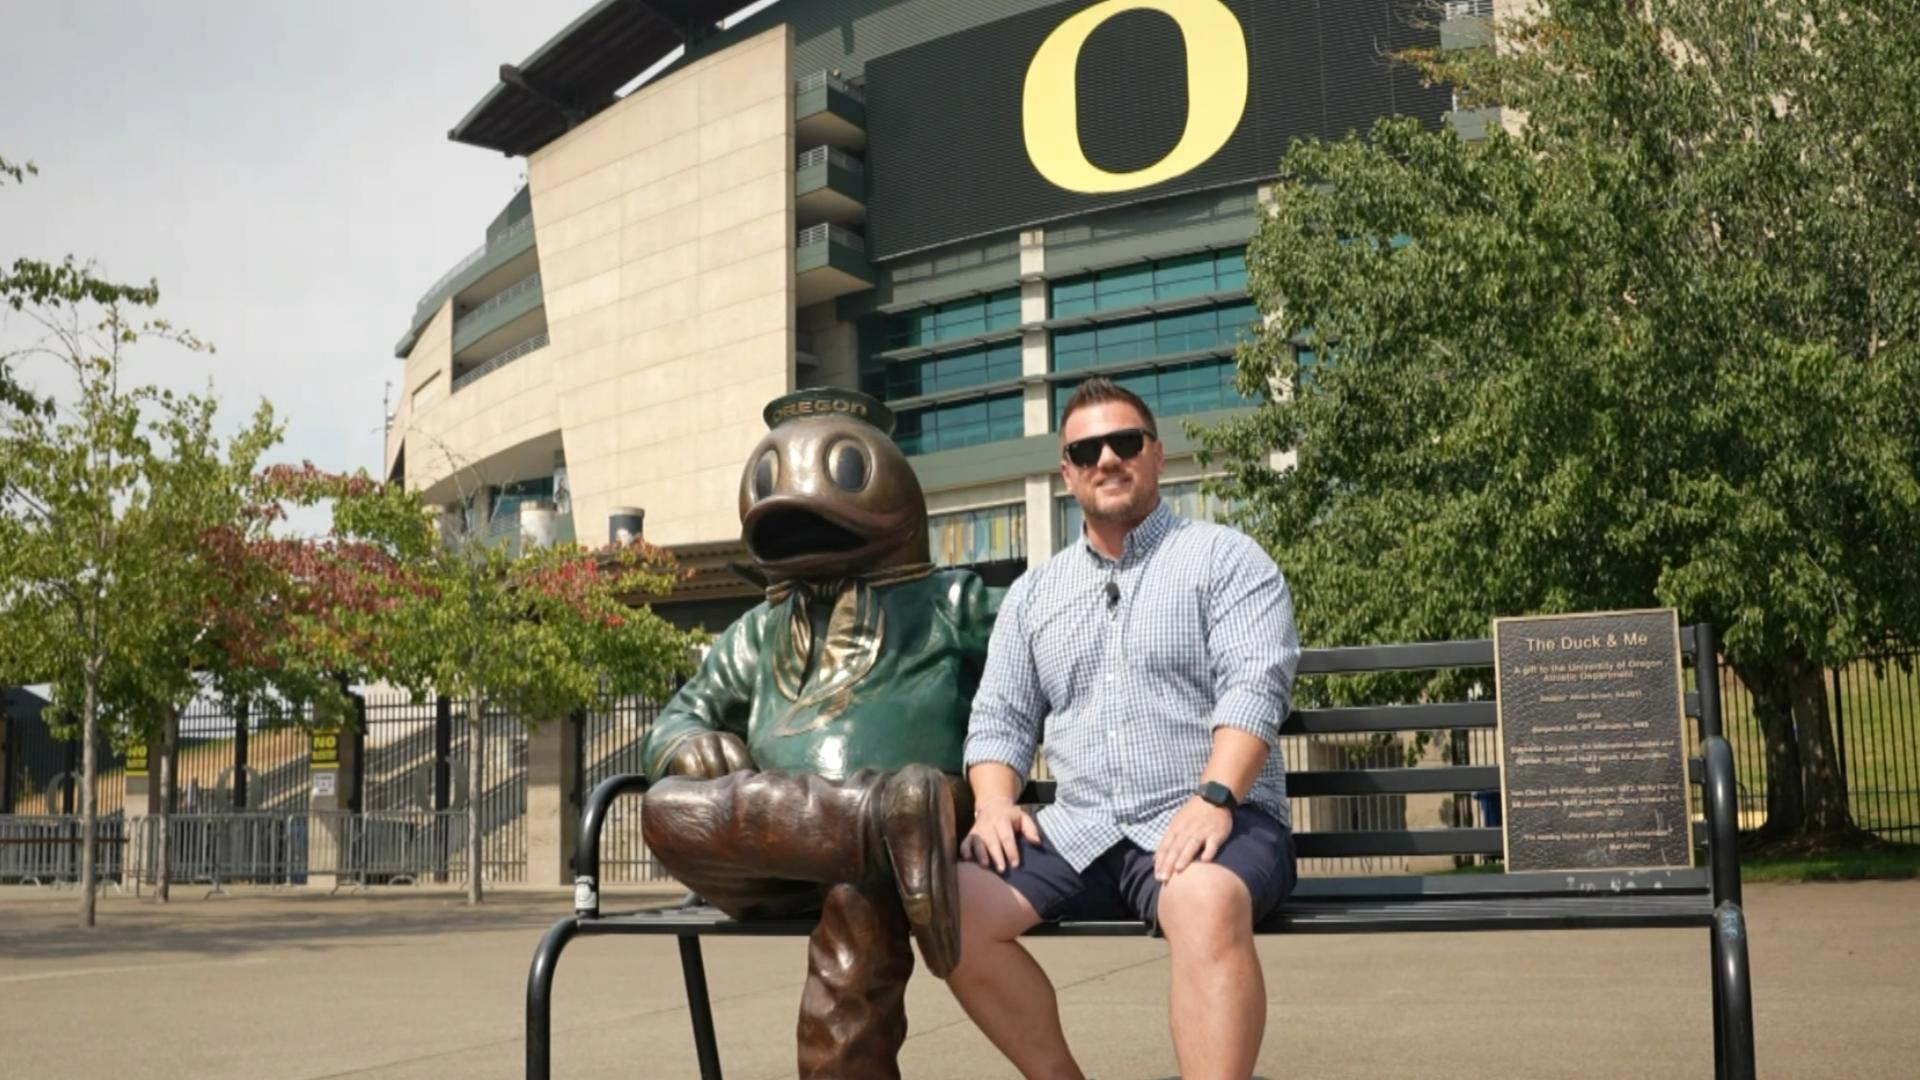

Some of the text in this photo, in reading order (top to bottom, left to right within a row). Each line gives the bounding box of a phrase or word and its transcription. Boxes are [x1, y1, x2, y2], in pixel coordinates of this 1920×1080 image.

[1022, 0, 1249, 194] O
[1526, 632, 1649, 652] The Duck & Me
[1568, 662, 1614, 673] University
[1628, 659, 1664, 671] Oregon
